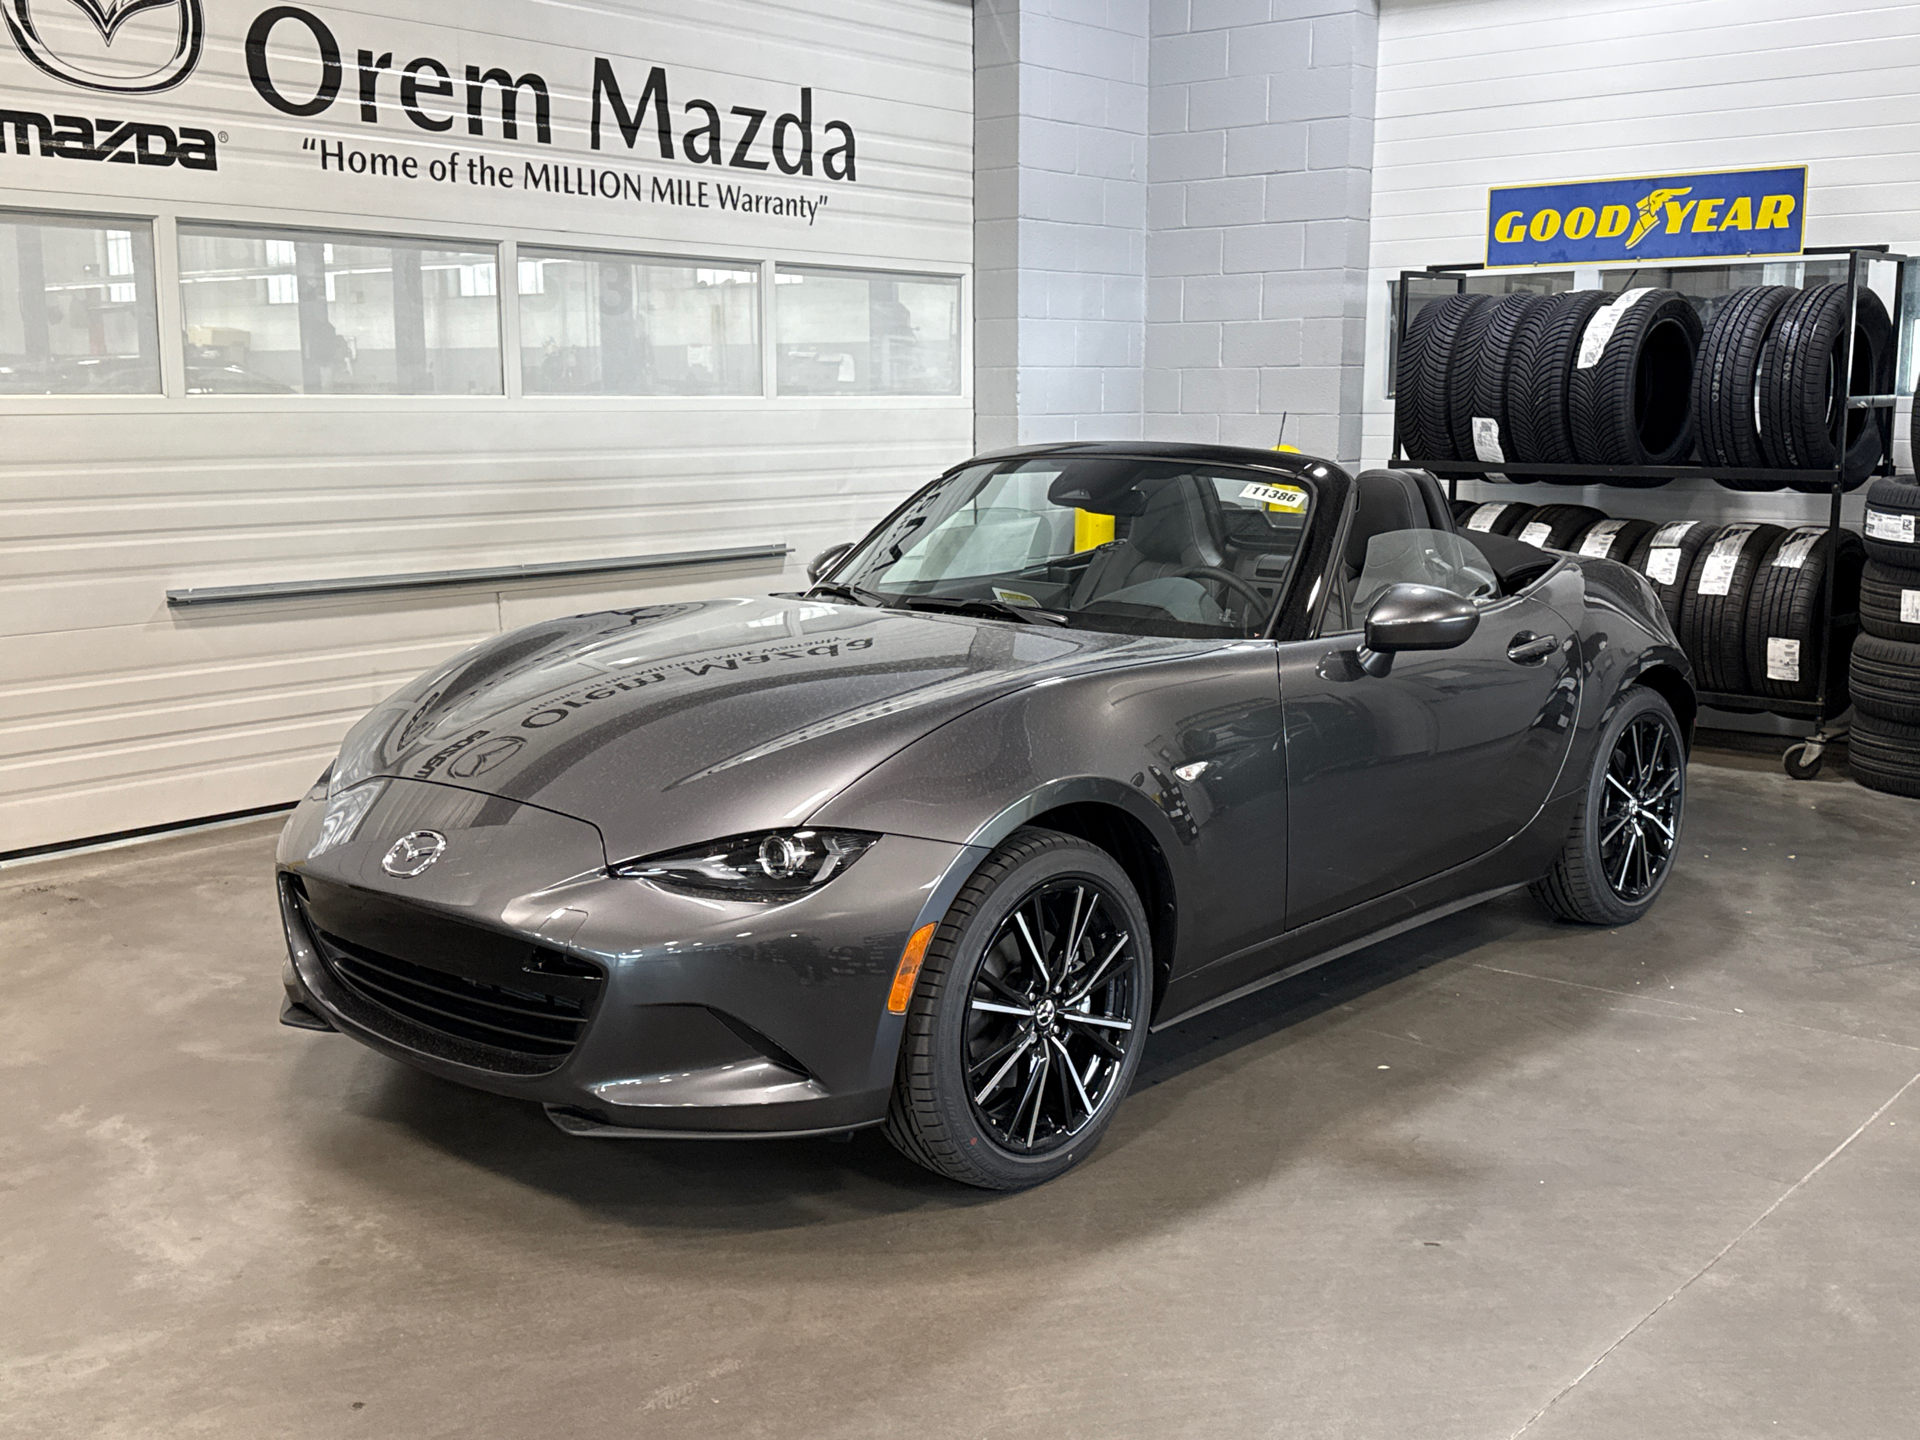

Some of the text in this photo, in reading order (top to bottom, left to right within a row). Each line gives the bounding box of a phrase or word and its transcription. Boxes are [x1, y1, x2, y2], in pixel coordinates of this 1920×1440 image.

[244, 5, 857, 182] Orem Mazda
[429, 153, 460, 183] of
[467, 158, 514, 188] the
[524, 161, 641, 201] MILLION
[651, 176, 709, 208] MILE
[1252, 486, 1298, 503] 11386
